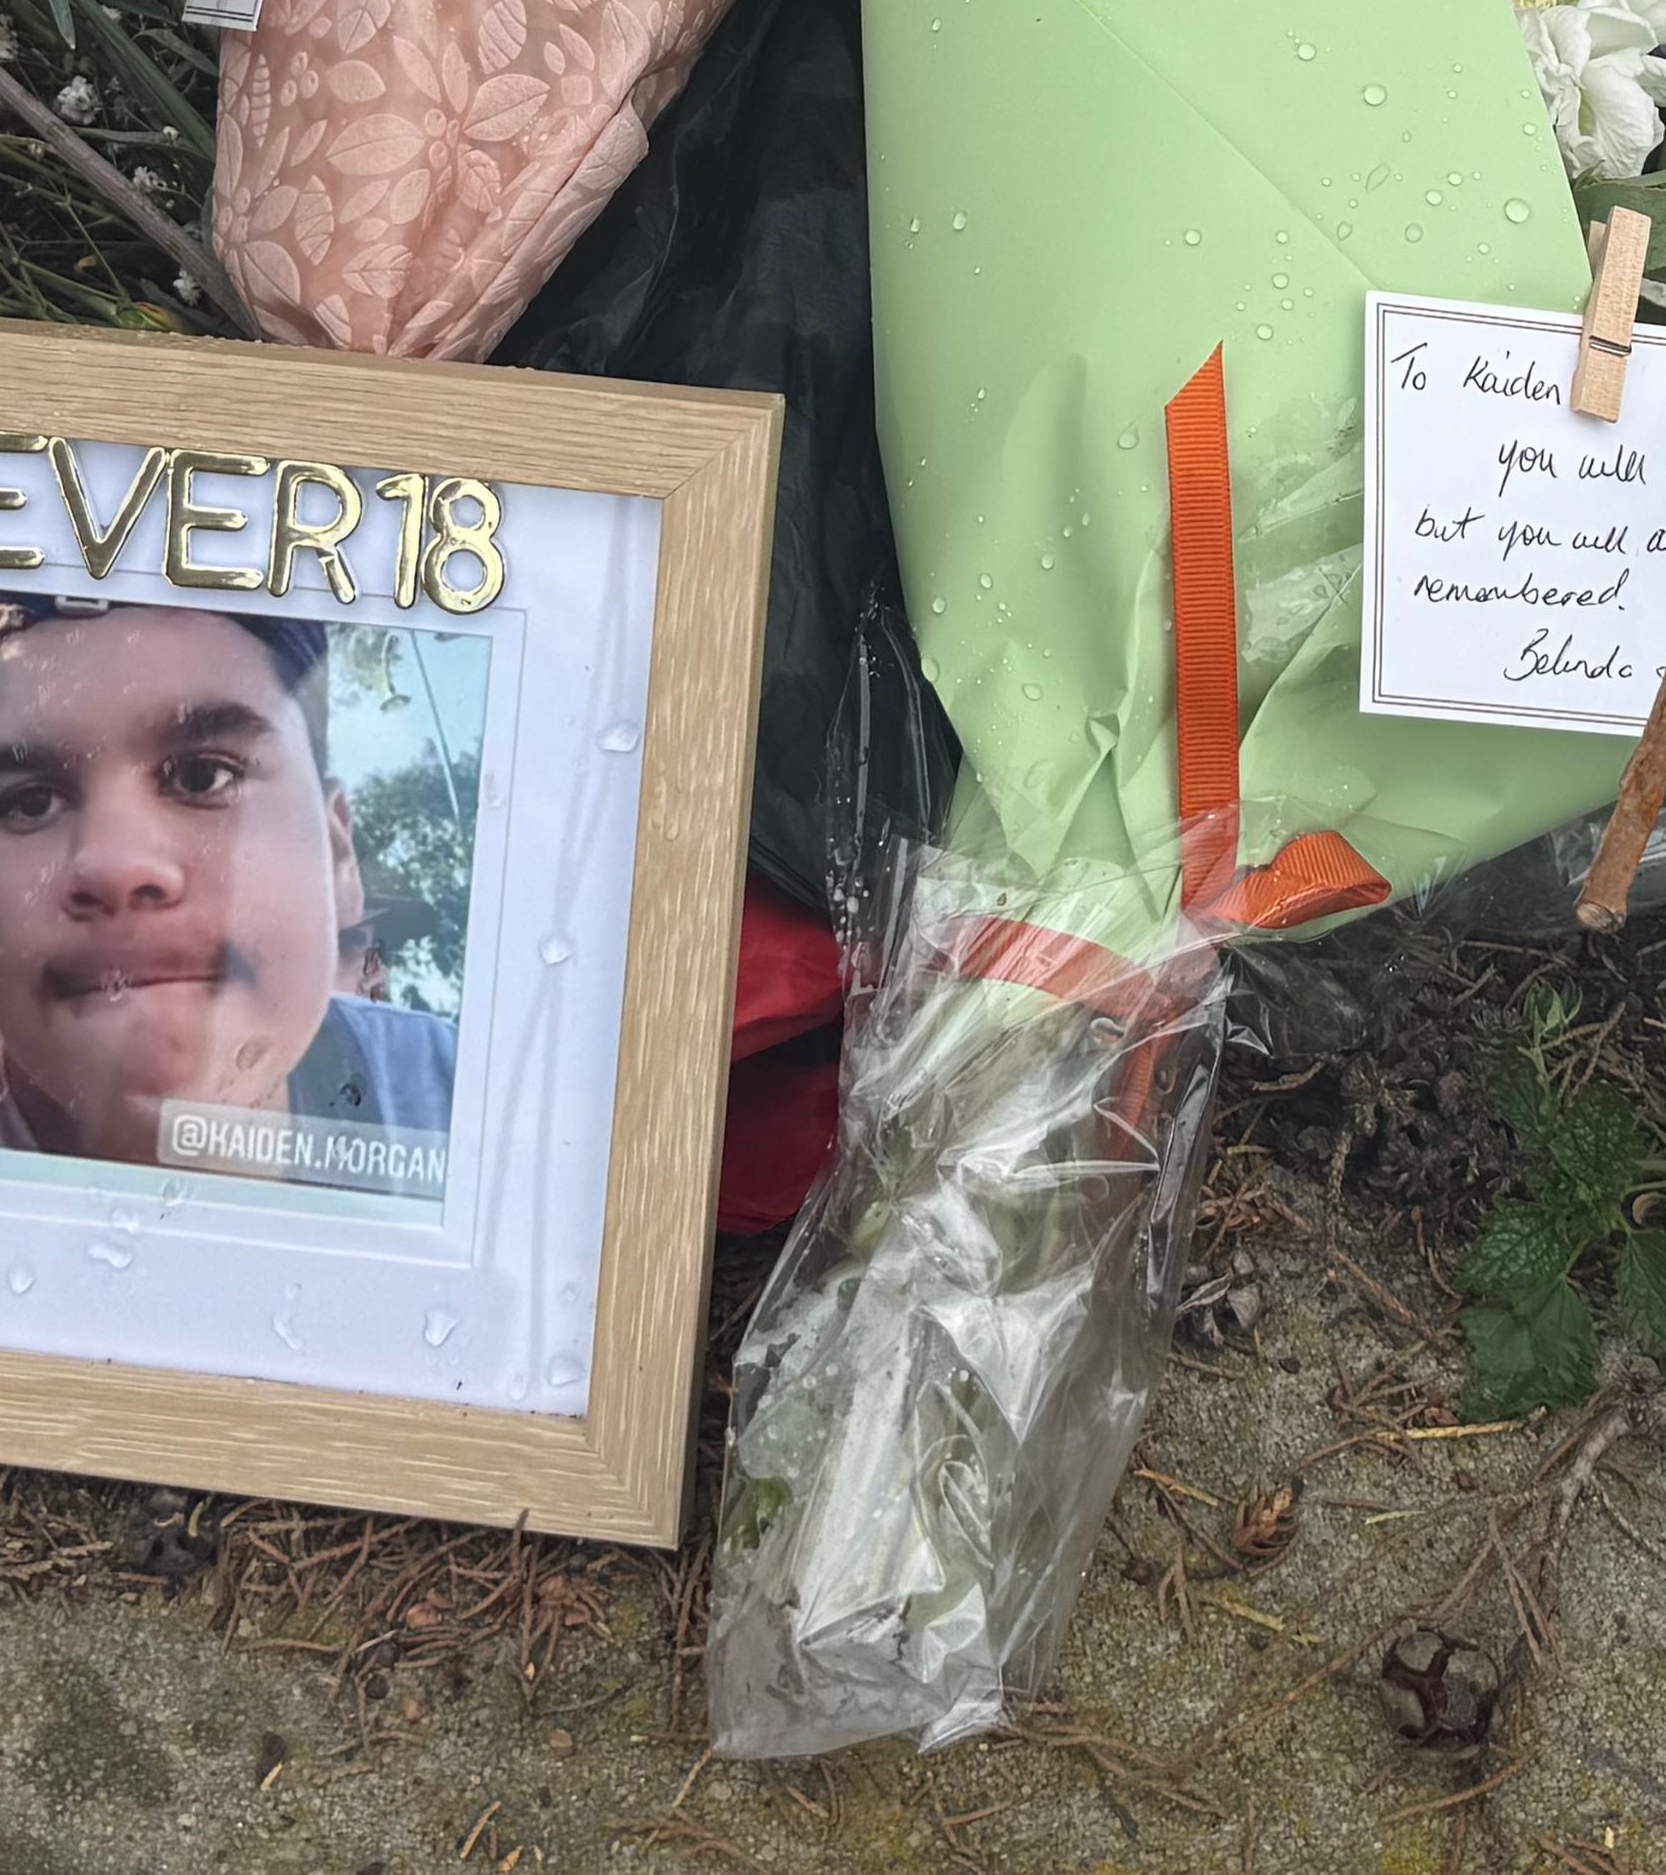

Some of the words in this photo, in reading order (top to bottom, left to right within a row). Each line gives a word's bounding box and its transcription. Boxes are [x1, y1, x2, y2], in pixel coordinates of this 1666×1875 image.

[1390, 340, 1428, 393] To
[1461, 350, 1562, 407] Kaiden
[1497, 438, 1559, 498] you
[1414, 503, 1486, 541] but
[1497, 519, 1562, 562] you
[1502, 627, 1634, 683] Belinda
